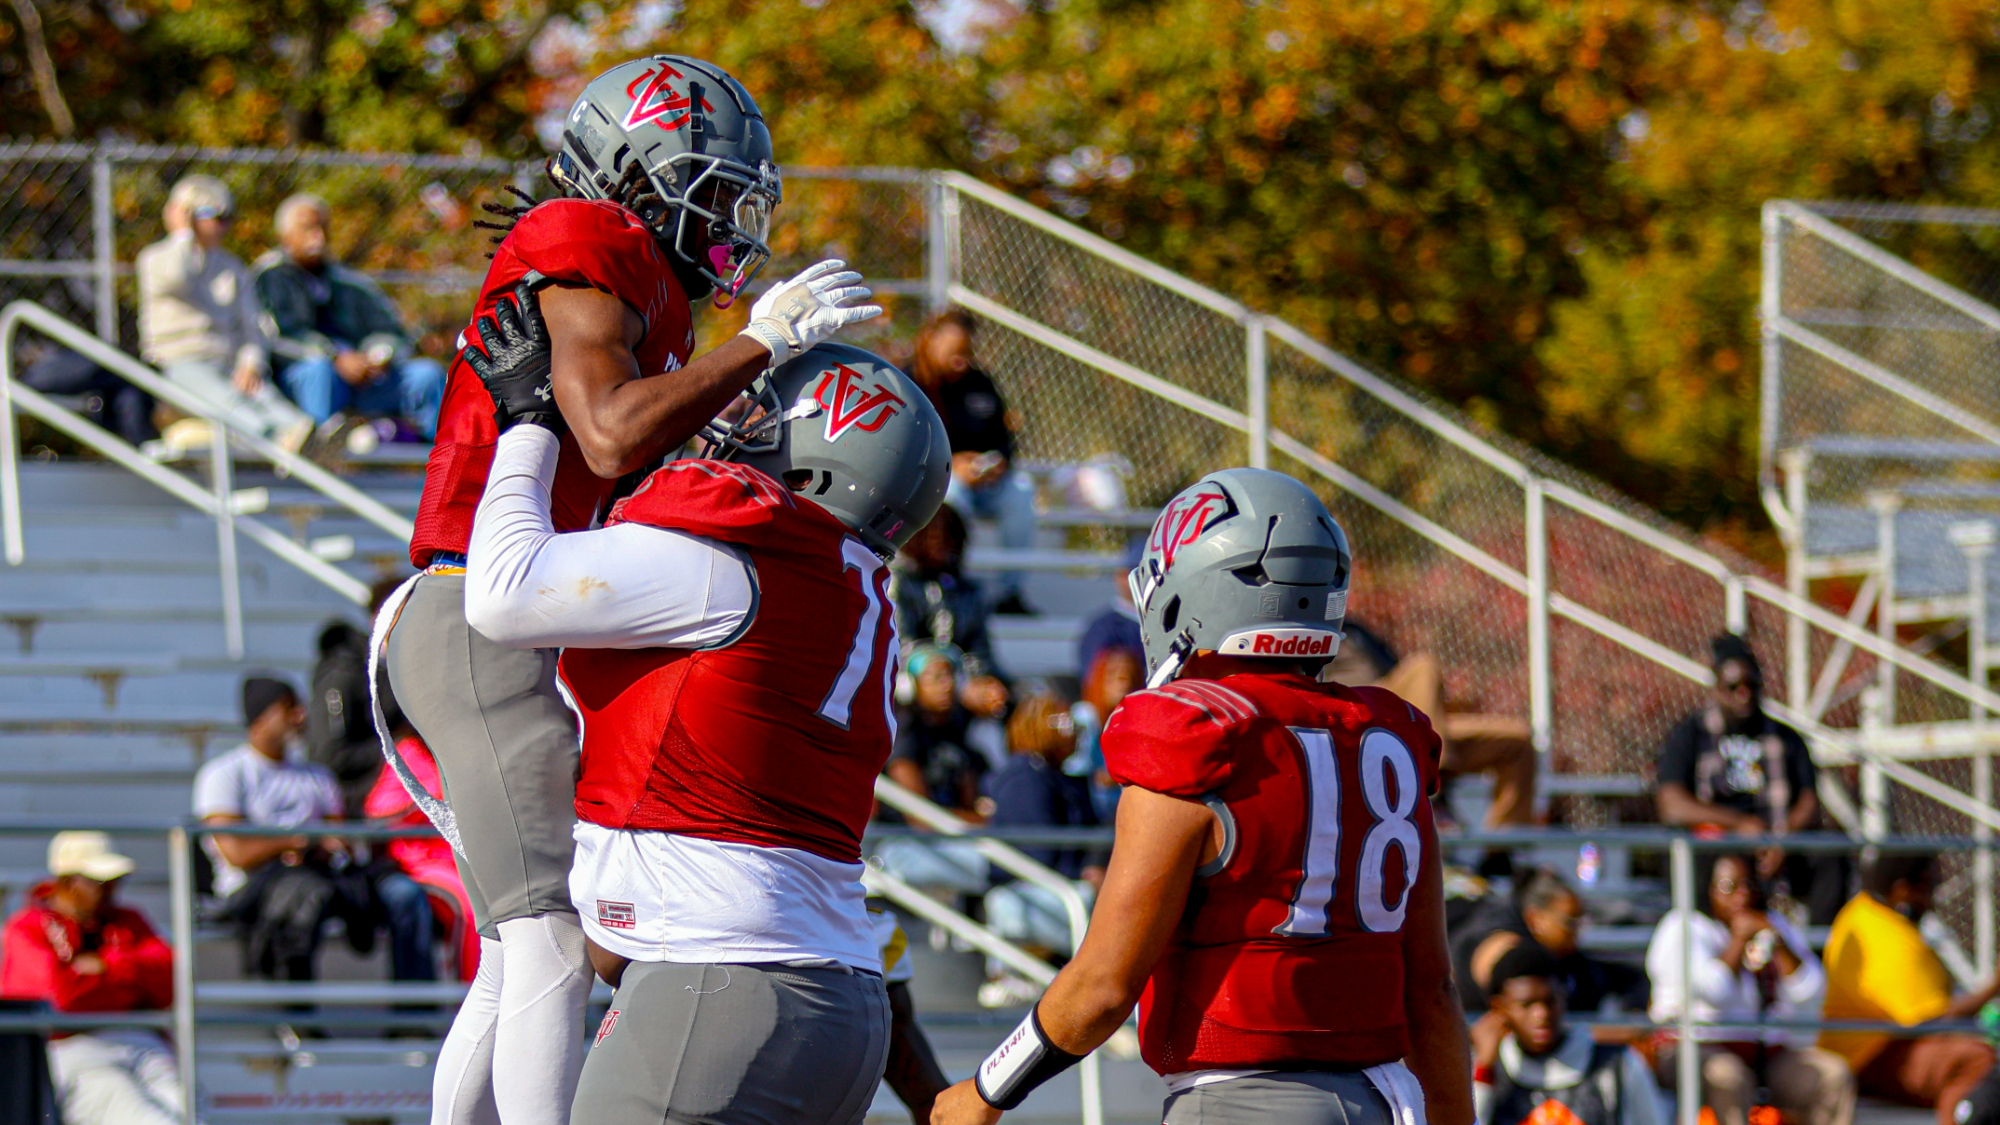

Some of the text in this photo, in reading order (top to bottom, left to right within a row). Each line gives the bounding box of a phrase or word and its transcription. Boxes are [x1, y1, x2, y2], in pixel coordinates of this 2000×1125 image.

[572, 100, 588, 122] C
[1252, 634, 1333, 655] Riddell
[1271, 726, 1421, 937] 18
